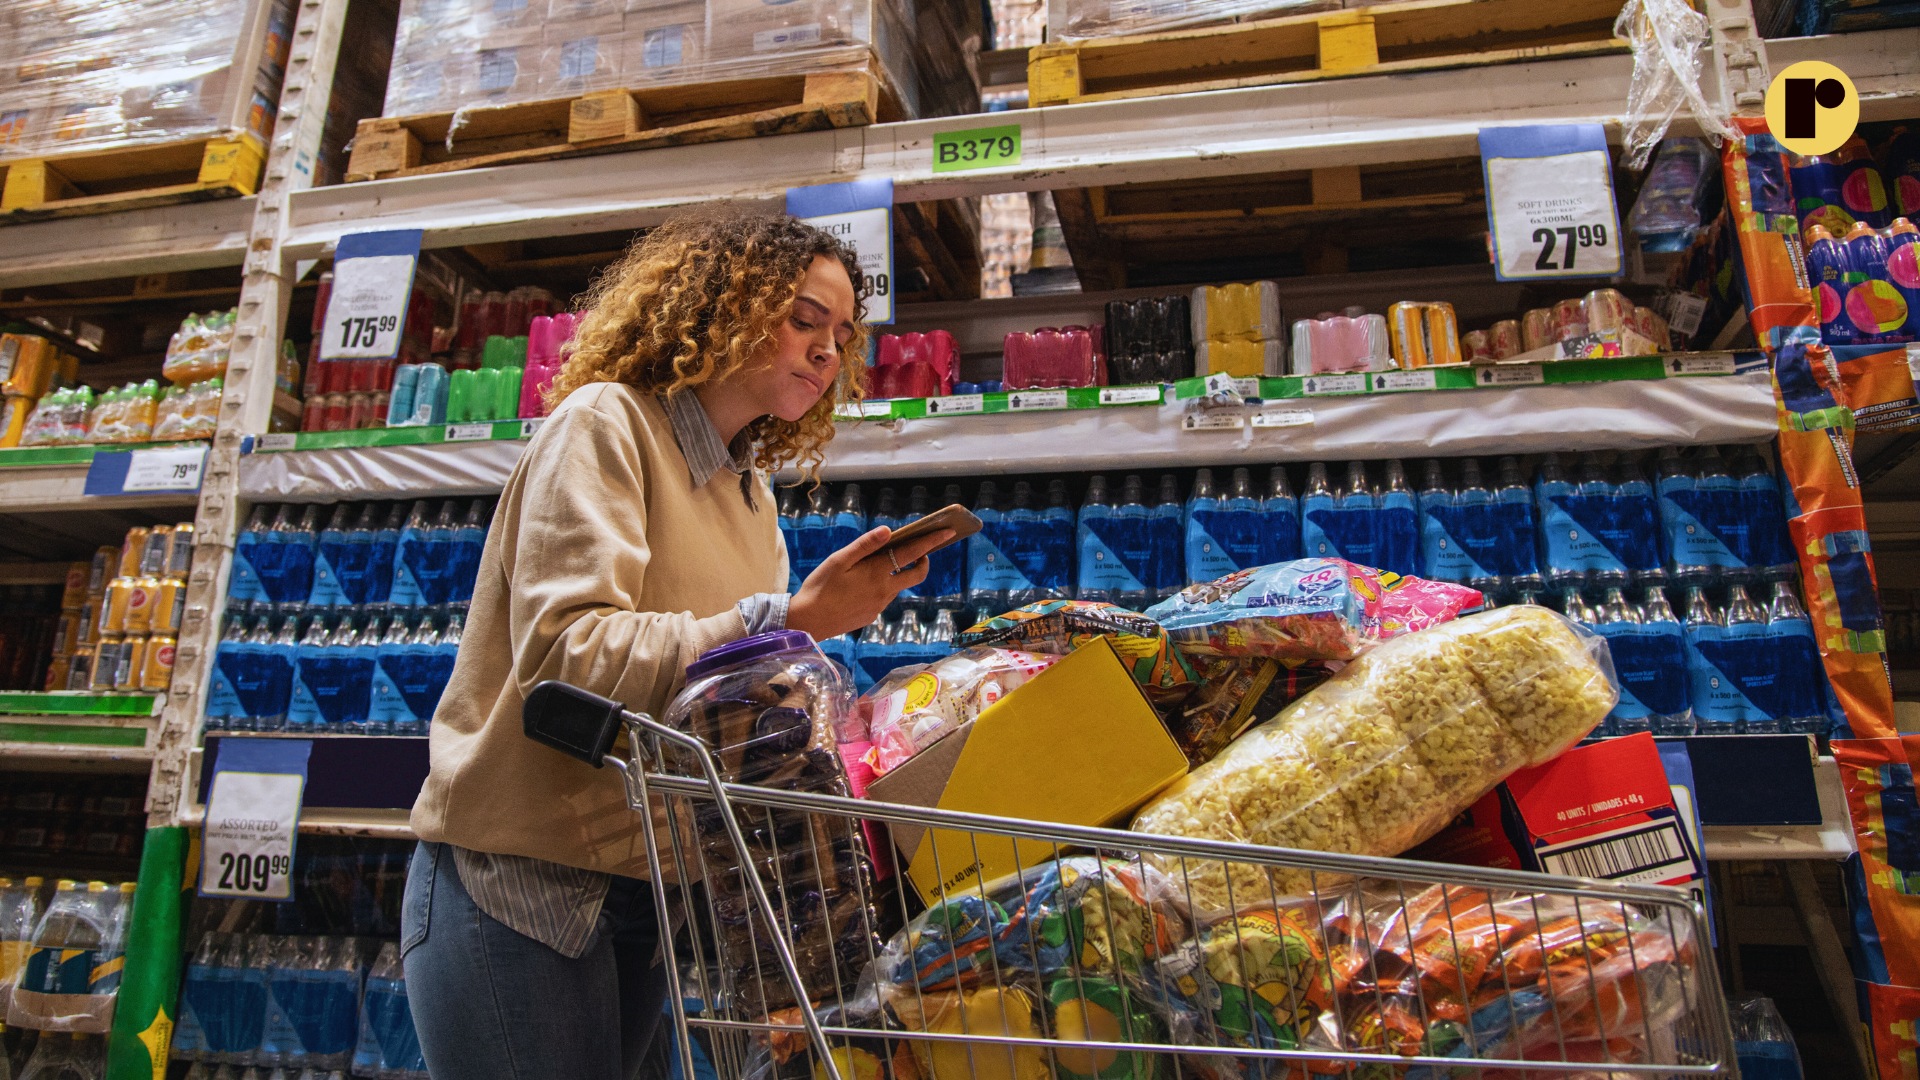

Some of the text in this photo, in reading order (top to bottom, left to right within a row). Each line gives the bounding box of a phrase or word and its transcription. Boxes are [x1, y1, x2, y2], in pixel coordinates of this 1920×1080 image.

[939, 136, 1015, 164] B379
[1517, 197, 1583, 210] SOFT DRINKS
[1530, 214, 1576, 225] 6x300ML
[1785, 240, 1805, 289] REFRESHMENT
[1856, 400, 1910, 416] REFRESHMENT
[1857, 410, 1912, 425] REHYDRATION
[1829, 434, 1854, 488] REFRESHMENT
[1557, 810, 1567, 822] 40
[1567, 807, 1586, 819] UNITS
[1591, 797, 1623, 813] UNIDADES
[219, 819, 278, 832] ASSORTED
[955, 871, 965, 883] 40
